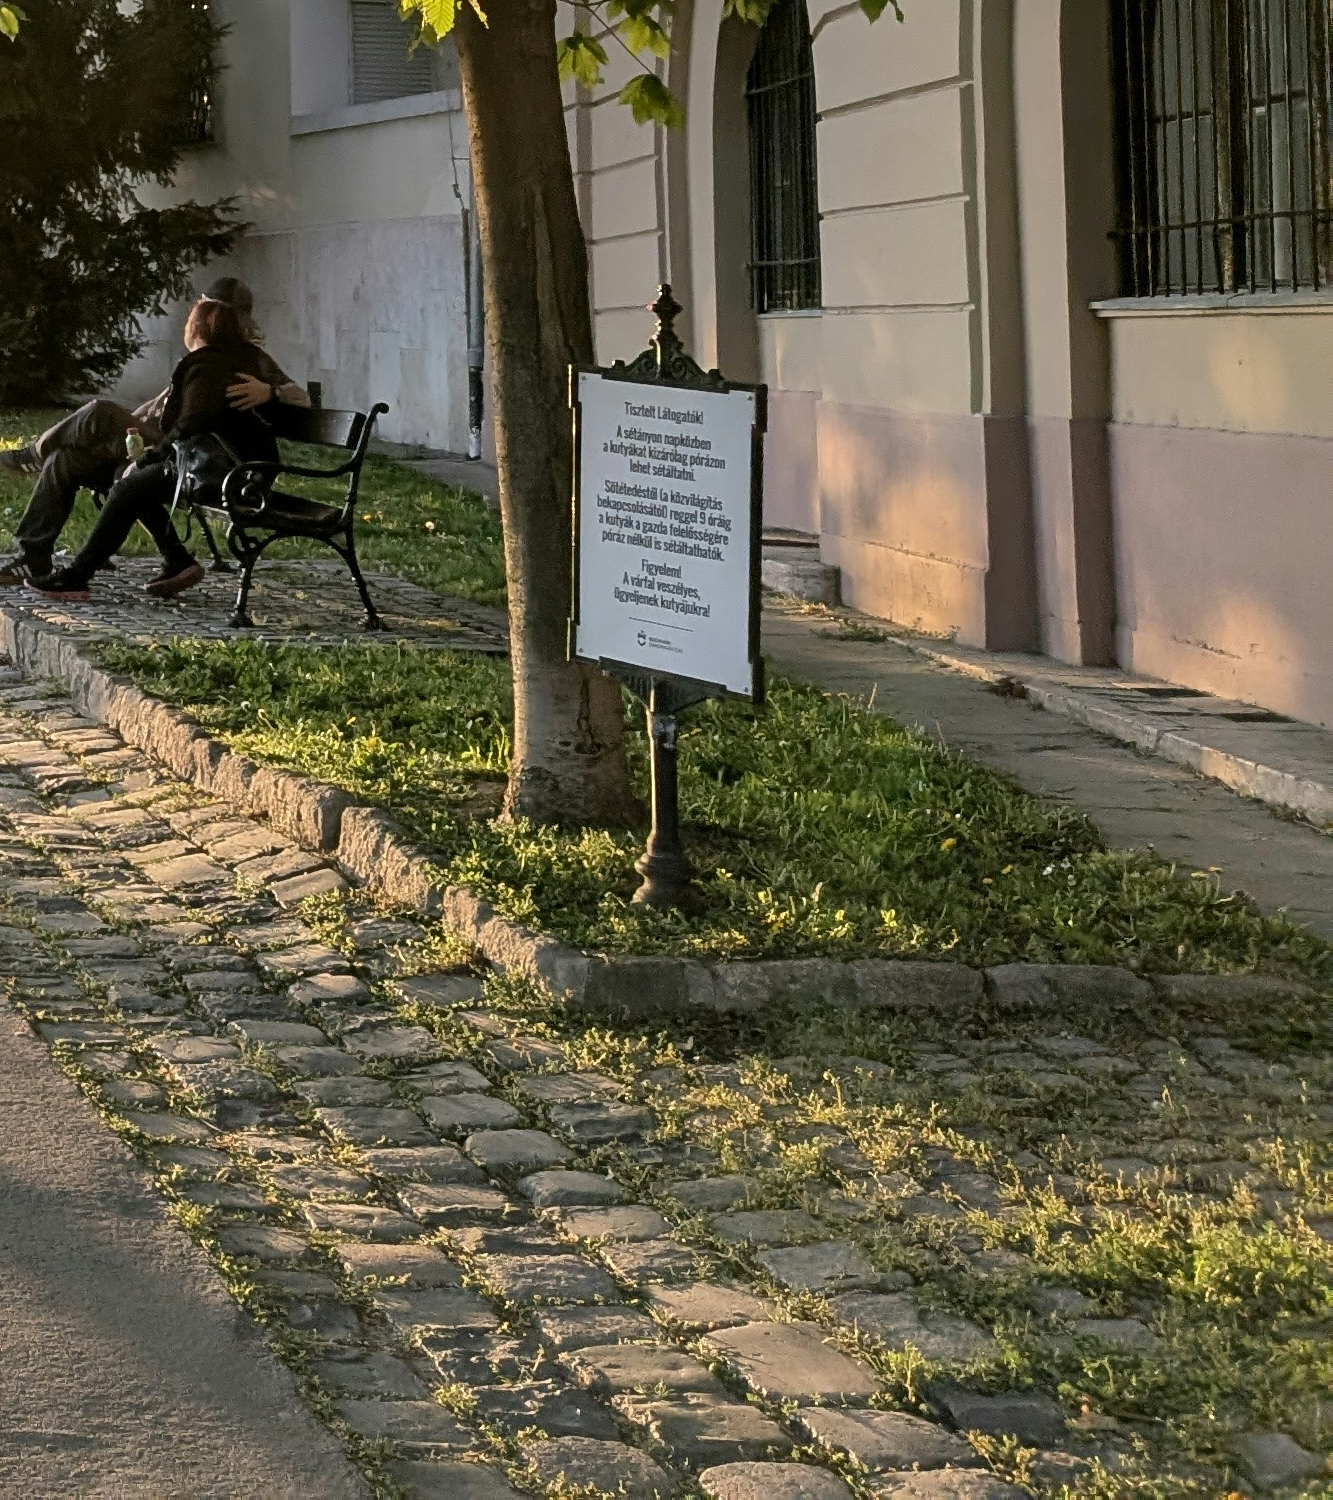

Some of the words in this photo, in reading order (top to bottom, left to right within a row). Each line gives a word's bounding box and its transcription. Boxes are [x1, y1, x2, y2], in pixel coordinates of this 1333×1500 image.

[625, 402, 655, 419] Tisztelt
[658, 406, 703, 424] Látogatók!
[616, 425, 622, 438] A
[624, 427, 662, 444] sétányon
[664, 434, 711, 451] napközben
[602, 442, 608, 452] a
[610, 440, 646, 457] kutyákat
[648, 446, 688, 466] kizárólag
[690, 453, 725, 469] pórázon
[630, 459, 651, 475] lehet
[653, 464, 696, 481] sétáltatni.
[660, 488, 668, 502] (a
[670, 490, 723, 511] közvilágítás
[597, 494, 667, 518] bekapcsolásától)
[670, 509, 697, 525] reggel
[699, 512, 705, 524] 9
[708, 513, 731, 532] óráig
[598, 513, 603, 523] a
[606, 512, 633, 529] kutyák
[635, 520, 640, 530] a
[642, 521, 667, 535] gazda
[670, 523, 729, 545] felelősségére
[602, 529, 625, 543] póráz
[627, 533, 652, 548] nélkül
[654, 537, 661, 550] is
[642, 559, 681, 579] Figyelem!
[623, 571, 629, 585] A
[631, 574, 655, 590] várfal
[657, 582, 700, 601] veszélyes,
[661, 595, 710, 618] kutyájukra!
